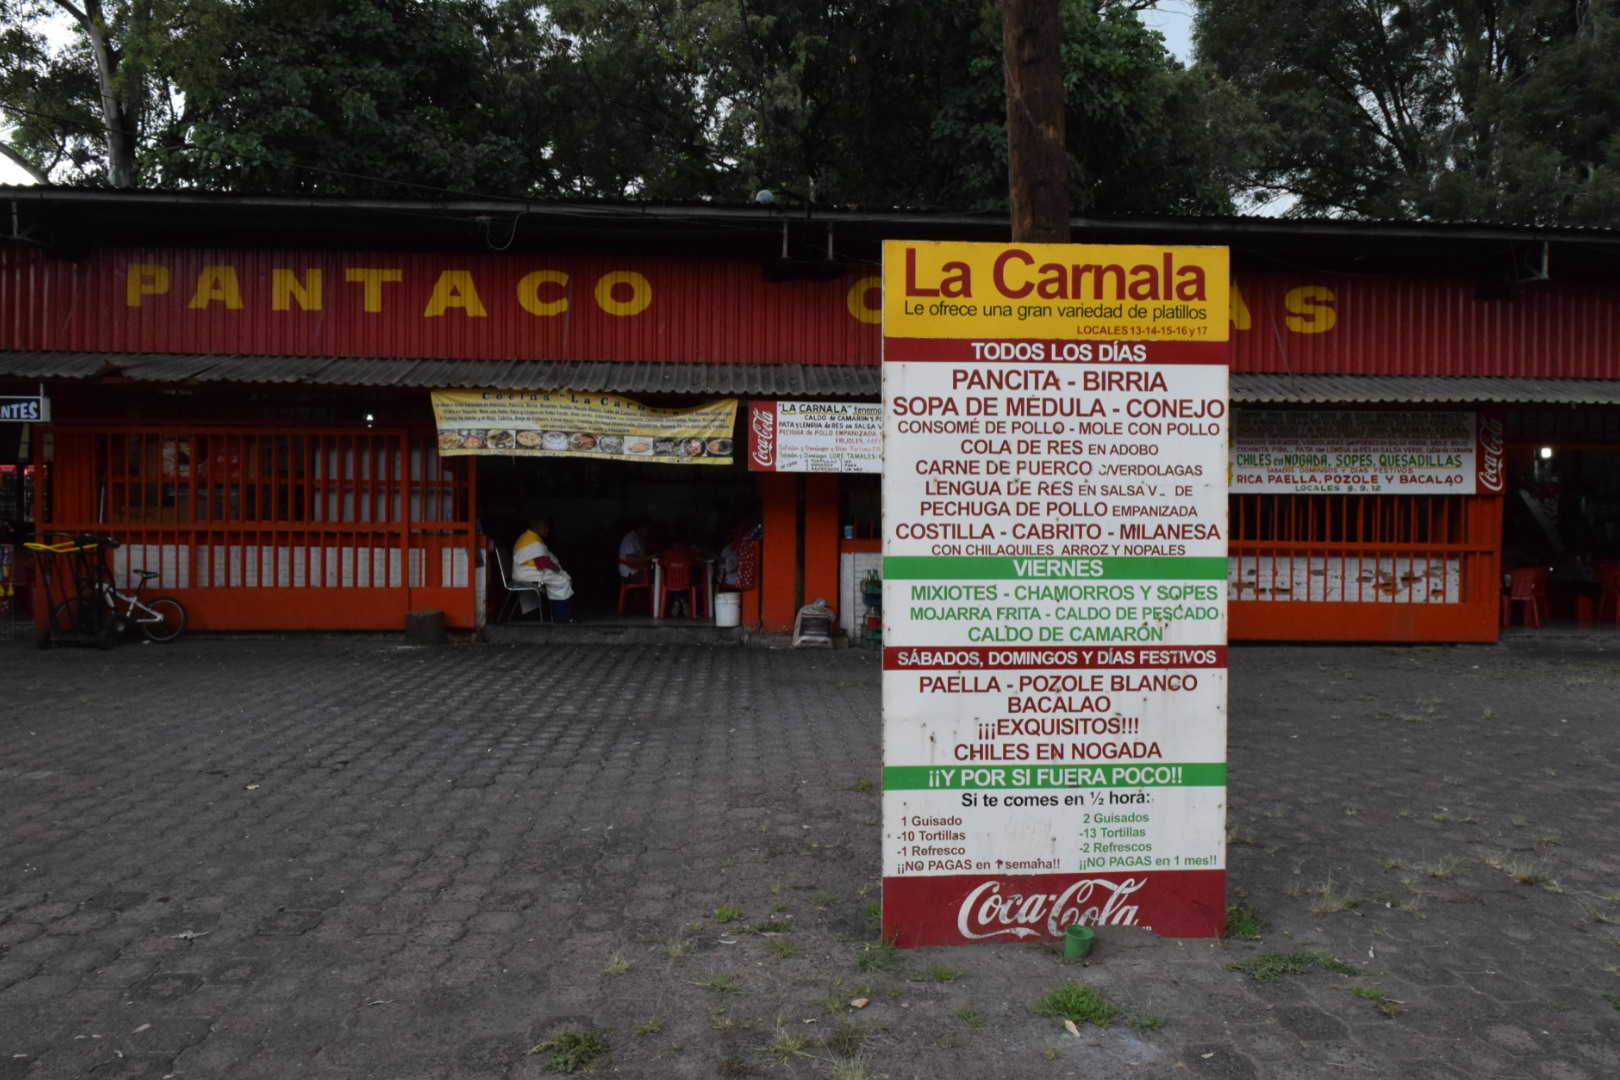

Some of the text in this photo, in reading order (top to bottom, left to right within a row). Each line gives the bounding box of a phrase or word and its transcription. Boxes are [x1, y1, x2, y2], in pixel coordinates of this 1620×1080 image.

[906, 247, 1206, 301] La Carnala
[126, 264, 652, 317] PANTACO
[905, 300, 1207, 322] Le ofrece una gran variedad de platillos
[1077, 326, 1128, 335] LOCALES
[1196, 326, 1208, 335] 17
[971, 342, 1147, 361] TODOS LOS DÍAS
[953, 369, 1061, 390] PANCITA
[1084, 371, 1168, 392] BIRRIA
[854, 406, 882, 416] tenemo
[893, 396, 959, 416] SOPA
[966, 397, 998, 416] DE
[1006, 397, 1106, 417] MÉDULA
[1127, 399, 1225, 418] CONEJO
[898, 418, 980, 434] CONSOMÉ
[985, 421, 1006, 434] DE
[1012, 421, 1064, 435] POLLO
[1079, 422, 1123, 435] MOLE
[1128, 422, 1161, 435] CON
[1167, 423, 1220, 436] POLLO
[961, 439, 1158, 456] COLA DE RES EN ADOBO
[916, 460, 980, 475] CARNE
[987, 460, 1010, 475] DE
[1017, 460, 1092, 475] PUERCO
[1236, 454, 1272, 466] CHILES
[1379, 454, 1463, 468] QUESADILLAS
[926, 479, 1002, 495] LENGUA
[1007, 480, 1031, 495] DE
[1038, 481, 1073, 496] RES
[1079, 485, 1096, 496] EN
[1101, 485, 1144, 496] SALSA
[1236, 475, 1263, 484] RICA
[1324, 475, 1378, 484] POZOLE
[1385, 476, 1394, 484] Y
[921, 501, 1197, 517] PECHUGA DE POLLO EMPANIZADA
[896, 523, 995, 539] COSTILLA
[1012, 523, 1101, 539] CABRITO
[1120, 524, 1221, 540] MILANESA
[931, 543, 1185, 557] CON CHILAQUILES ARROZ Y NOPALES
[1013, 559, 1104, 577] VIERNES
[912, 584, 997, 600] MIXIOTES
[1014, 585, 1134, 603] CHAMORROS
[1140, 585, 1151, 600] Y
[1157, 585, 1218, 601] SOPES
[911, 607, 992, 620] MOJARRA
[997, 607, 1041, 620] FRITA
[1055, 607, 1111, 620] CALDO
[1116, 607, 1137, 620] DE
[1142, 605, 1219, 622] PESCADO
[968, 624, 1163, 642] CALDO DE CAMARÓN
[898, 648, 1216, 667] SÁBADOS, DOMINGOS Y DÍAS FESTIVOS
[920, 676, 1001, 693] PAELLA
[1020, 675, 1103, 693] POZOLE
[1111, 674, 1197, 691] BLANCO
[1008, 696, 1111, 713] BACALAO
[976, 717, 1138, 740] ¡¡¡EXQUISITOS!!!
[954, 742, 1162, 761] CHILES EN NOGADA
[929, 767, 1182, 787] ¡¡Y POR SI FUERA POCO!!
[962, 793, 977, 807] Si
[983, 794, 998, 807] te
[1004, 796, 1058, 806] comes
[1064, 796, 1084, 806] en
[902, 816, 962, 826] 1 Guisado
[1083, 812, 1149, 824] 2 Guisados
[897, 830, 966, 841] -10 Tortillas
[1080, 827, 1146, 838] -13 Tortillas
[912, 845, 965, 856] Refresco
[1080, 842, 1152, 853] -2 Refrescos
[898, 861, 924, 874] ¡¡NO
[928, 859, 972, 871] PAGAS
[1078, 855, 1216, 873] ¡¡NO PAGAS en 1 mes!!
